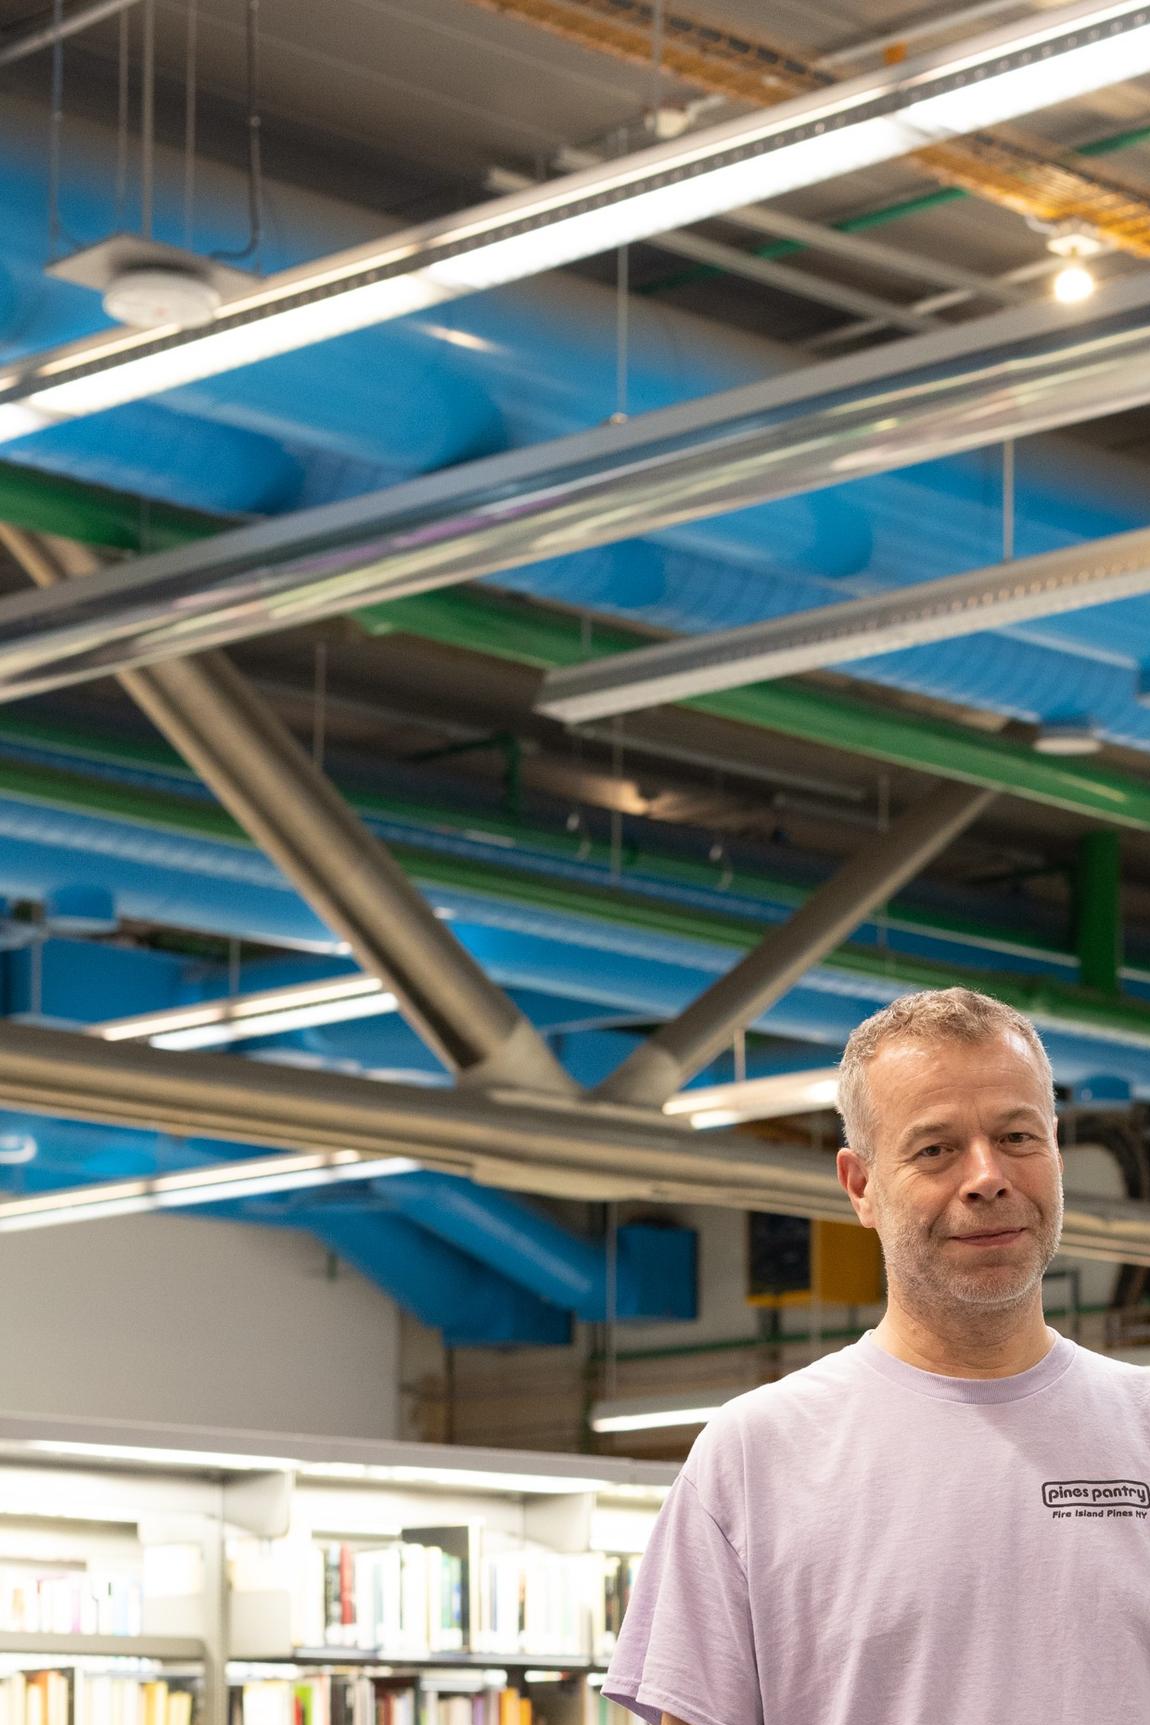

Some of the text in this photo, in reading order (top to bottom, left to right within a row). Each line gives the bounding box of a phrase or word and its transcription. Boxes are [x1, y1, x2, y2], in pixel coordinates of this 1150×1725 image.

[1048, 1485, 1146, 1503] pines pantry
[1052, 1510, 1072, 1519] Fire
[1075, 1509, 1104, 1518] Island
[1107, 1508, 1133, 1518] Pines
